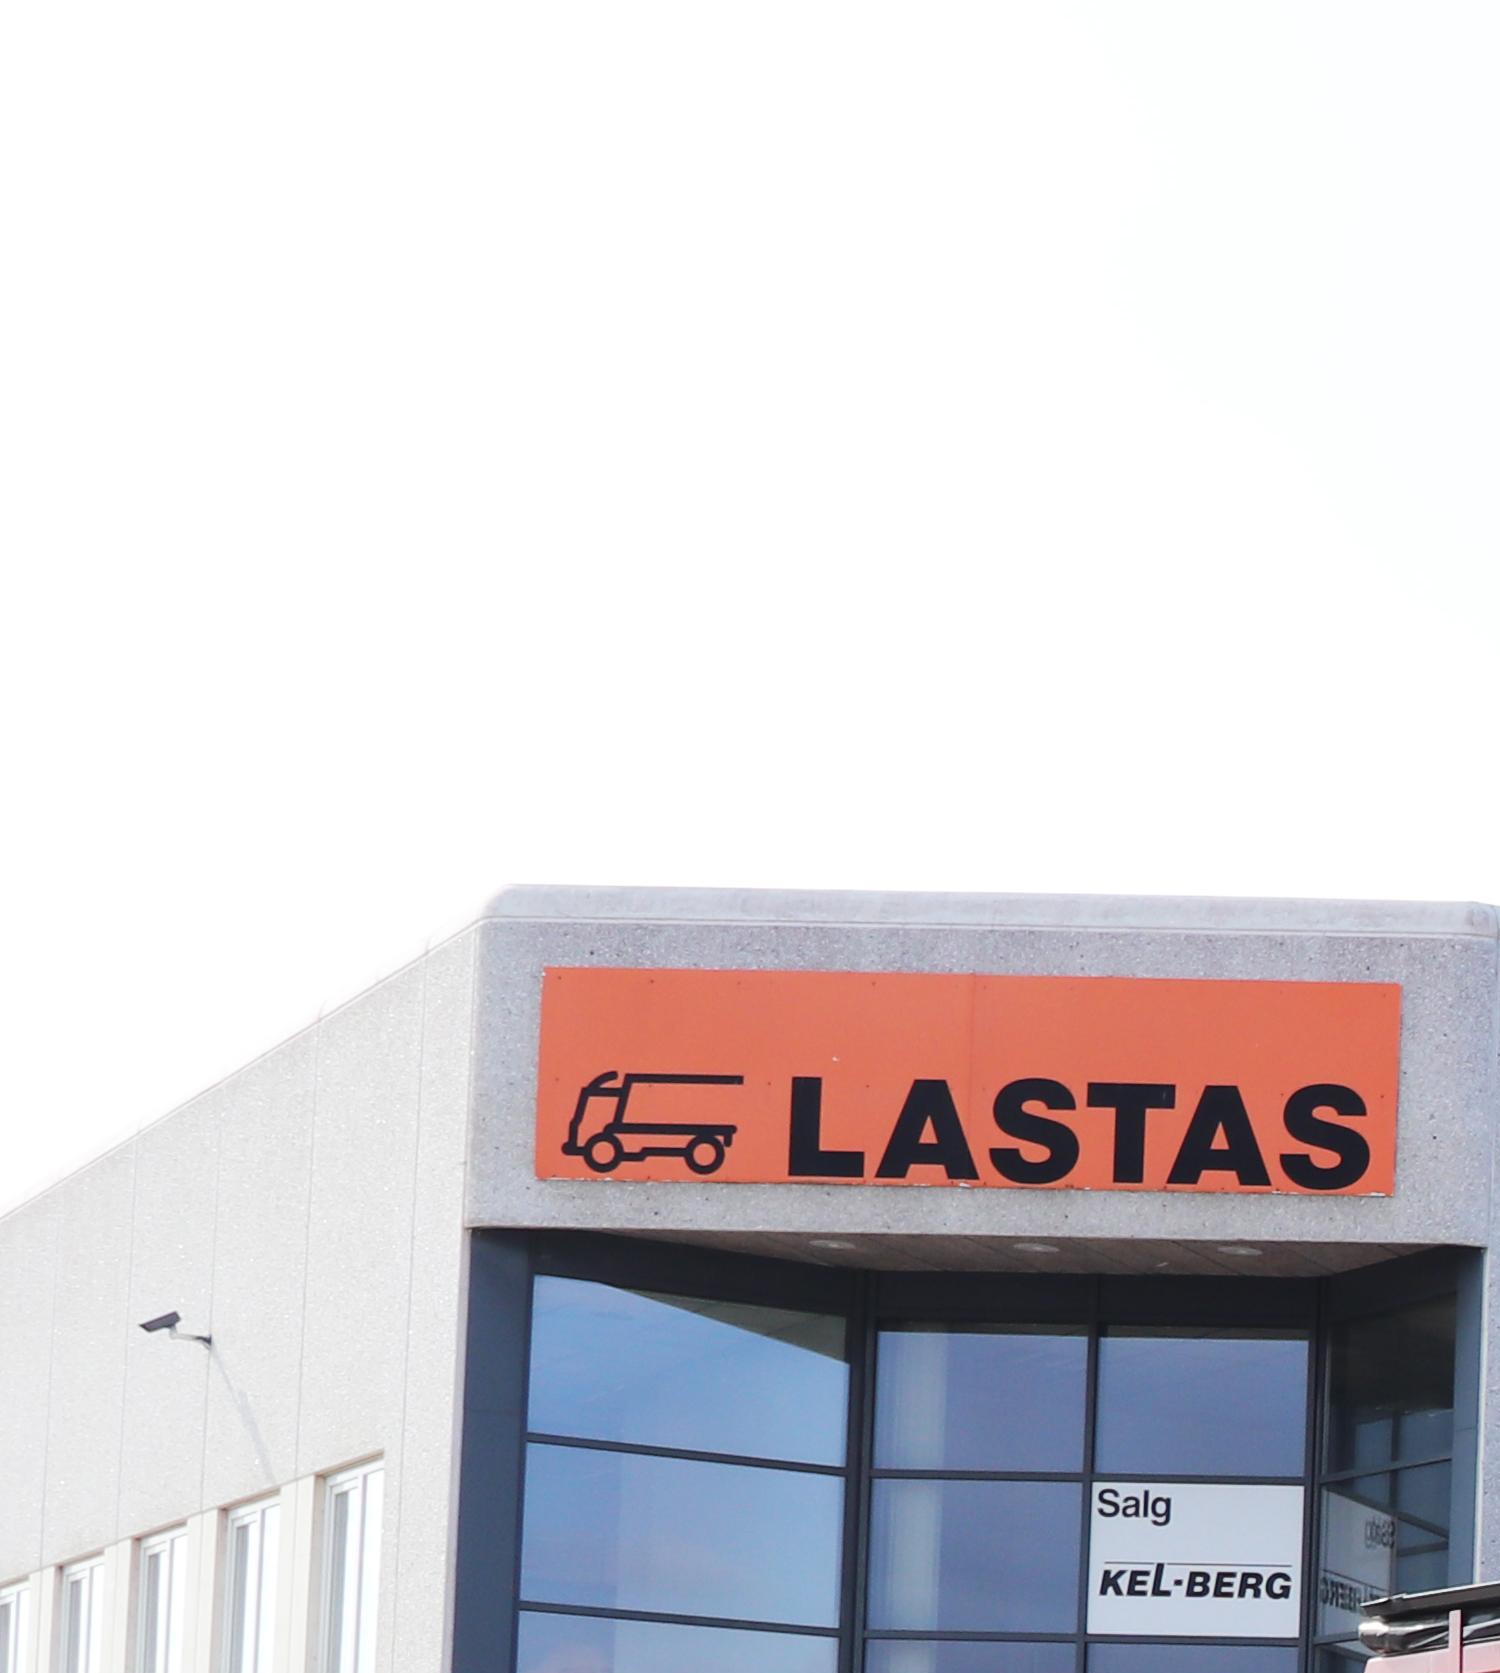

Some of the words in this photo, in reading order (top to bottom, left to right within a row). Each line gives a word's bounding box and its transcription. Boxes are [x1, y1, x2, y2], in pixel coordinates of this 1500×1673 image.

[789, 1076, 1372, 1191] LASTAS
[1097, 1488, 1172, 1526] Salg
[1098, 1562, 1293, 1600] KEL-BERG
